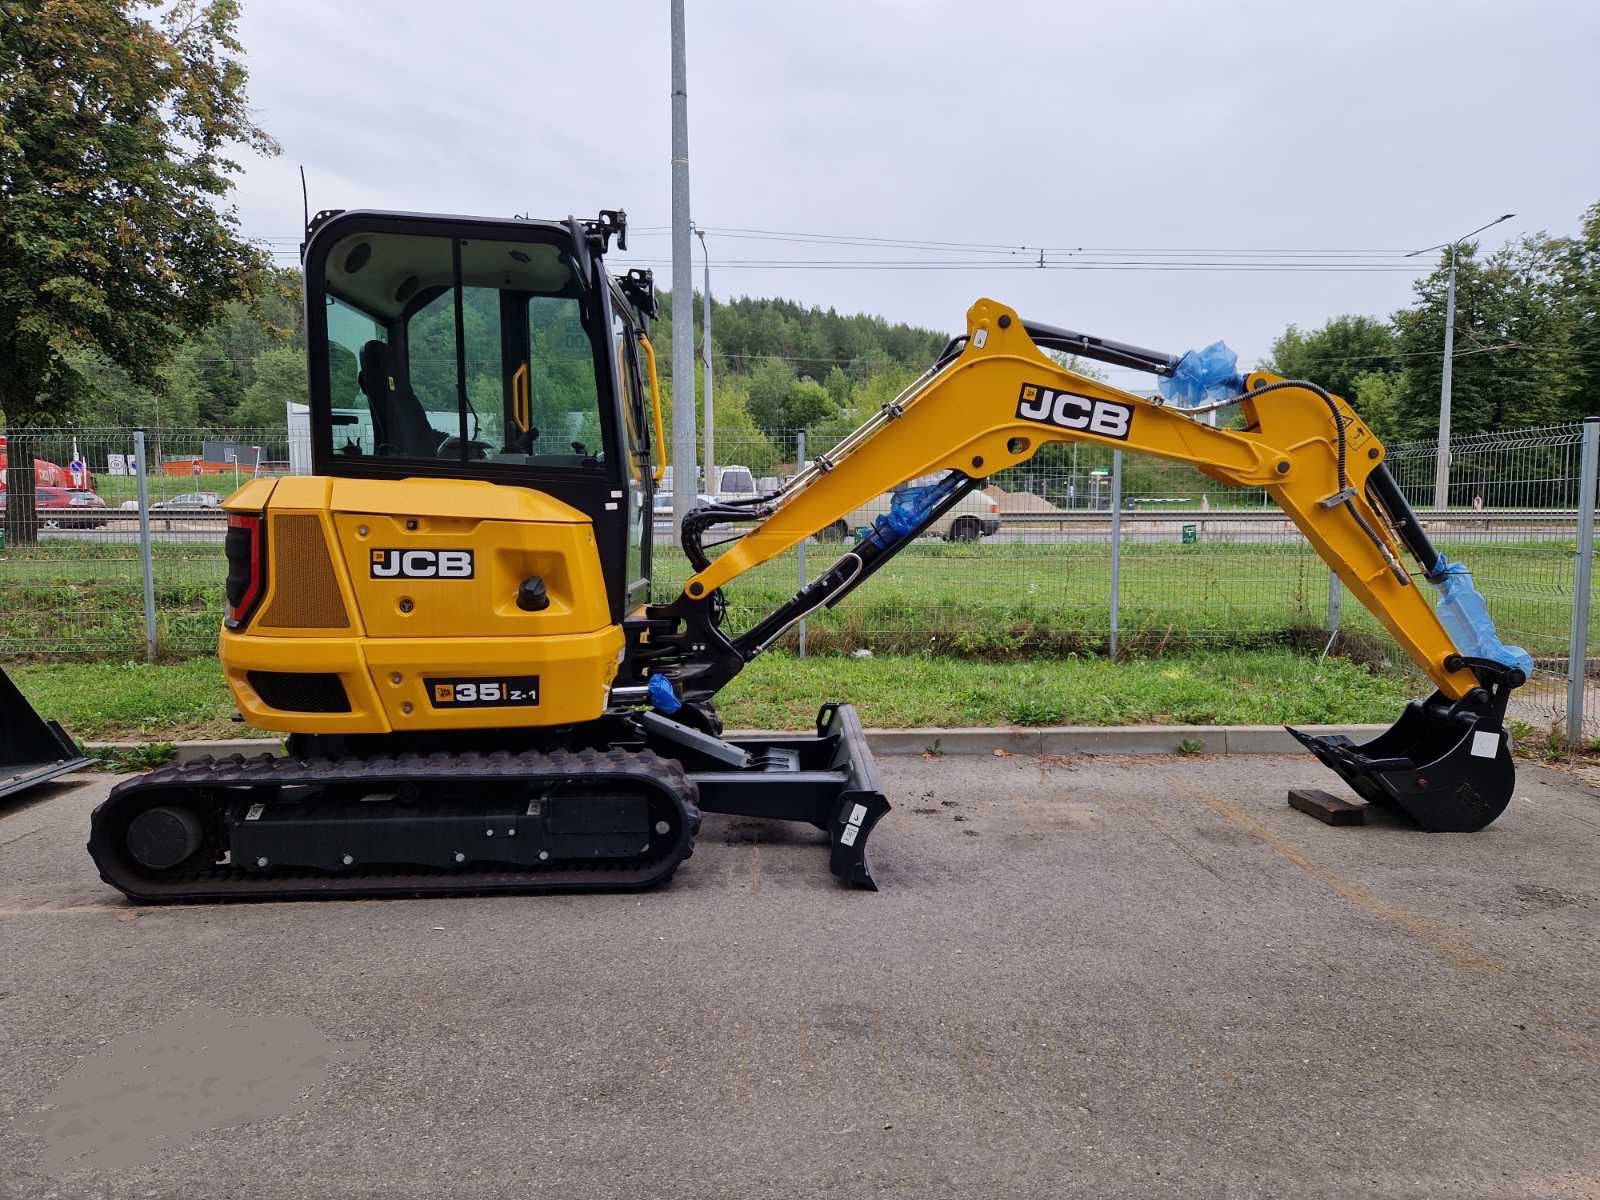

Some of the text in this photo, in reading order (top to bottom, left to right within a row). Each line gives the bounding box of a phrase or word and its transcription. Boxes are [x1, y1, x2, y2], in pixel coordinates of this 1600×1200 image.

[1020, 390, 1130, 436] JCB
[372, 550, 472, 577] JCB
[455, 682, 501, 702] 35
